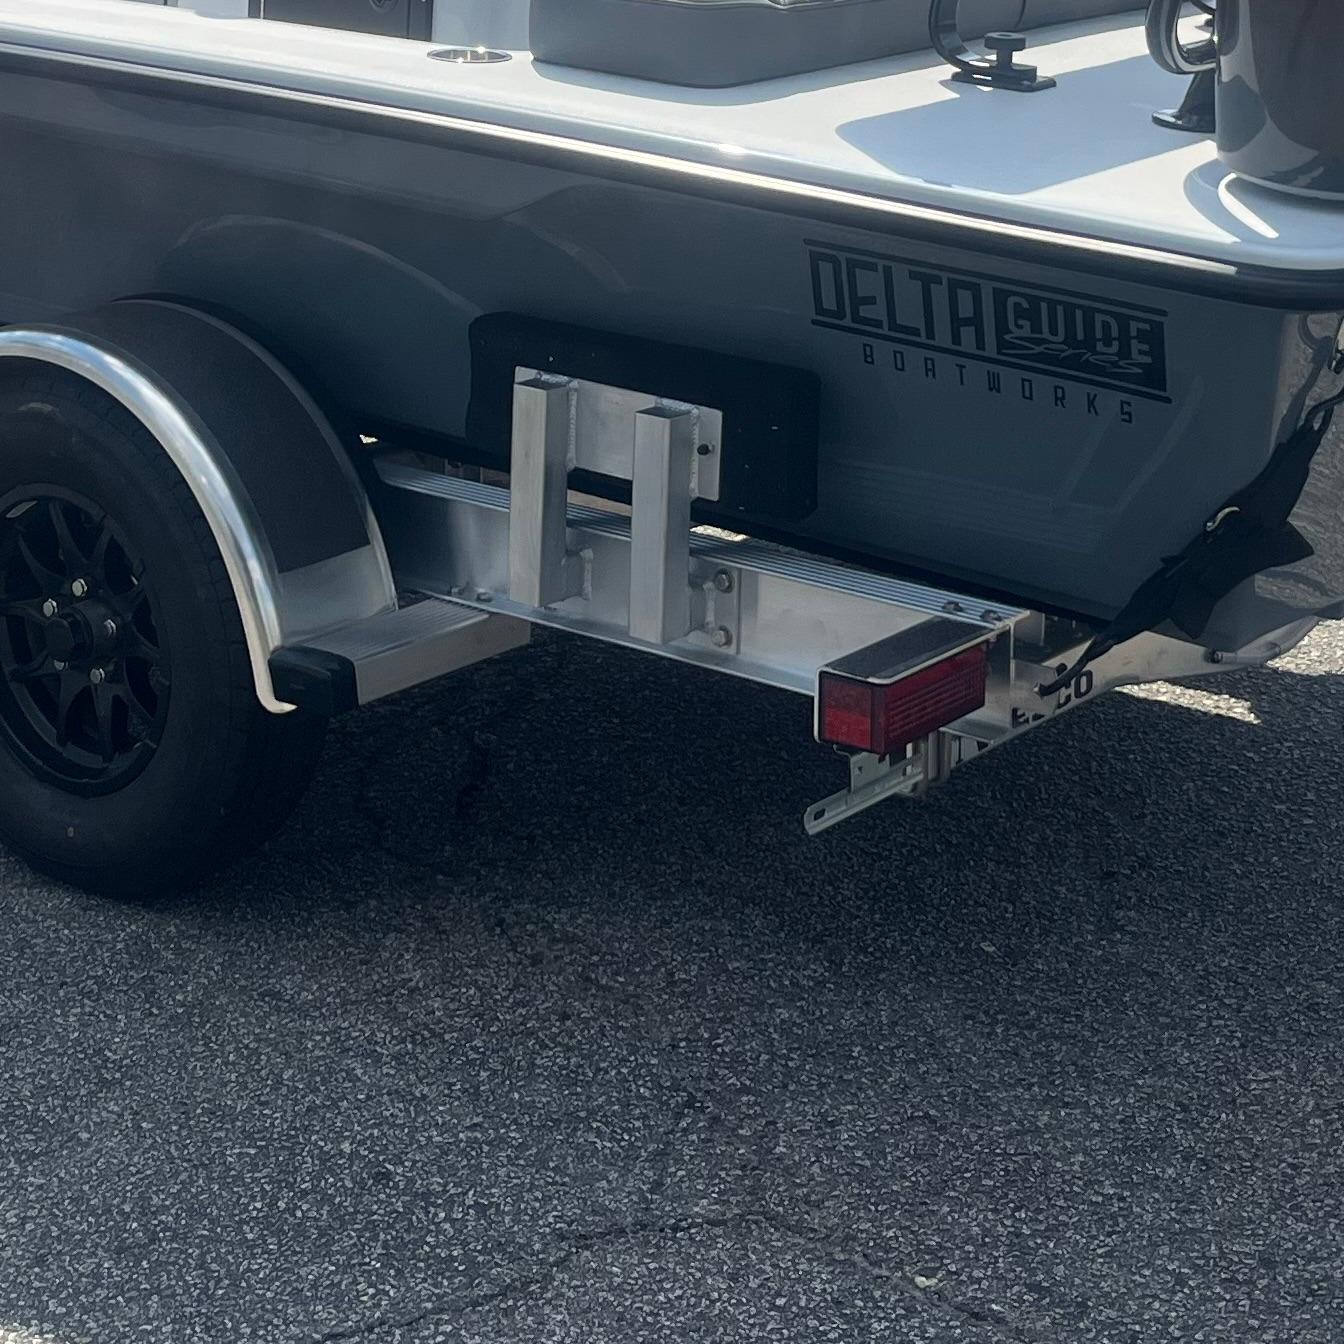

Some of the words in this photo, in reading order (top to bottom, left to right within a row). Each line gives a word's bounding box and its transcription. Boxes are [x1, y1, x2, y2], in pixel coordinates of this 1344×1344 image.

[808, 250, 986, 352] DELTA
[1006, 295, 1154, 363] GUIDE
[862, 343, 1134, 424] BOATWORKS
